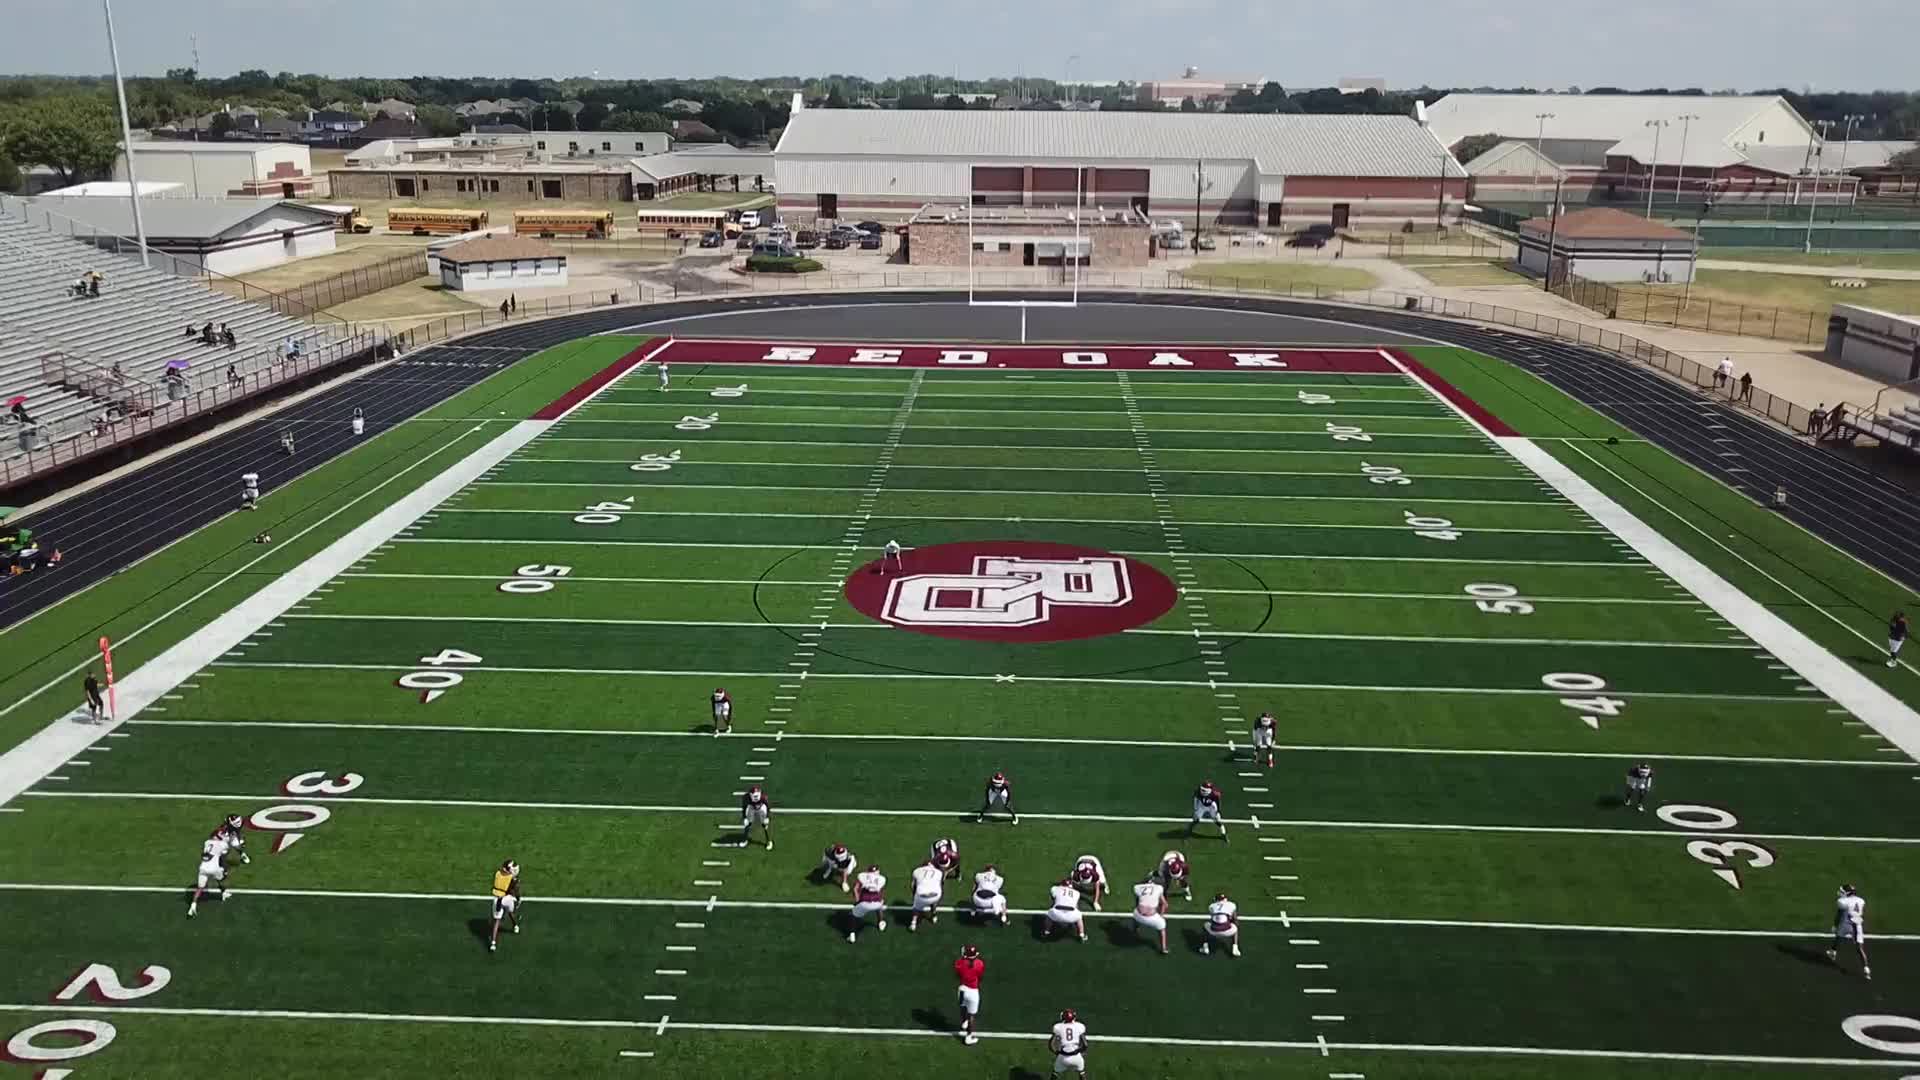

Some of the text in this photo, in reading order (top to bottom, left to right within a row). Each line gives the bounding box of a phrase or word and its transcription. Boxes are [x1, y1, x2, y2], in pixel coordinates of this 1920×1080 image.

[762, 346, 1288, 367] RED OAK
[675, 414, 719, 430] 20
[1327, 426, 1373, 442] 20
[630, 453, 682, 471] 30
[1361, 466, 1412, 485] 30
[573, 501, 632, 524] 40
[1405, 516, 1463, 540] 40
[499, 564, 573, 593] 50
[1464, 583, 1535, 614] 50
[398, 648, 483, 689] 40
[1541, 672, 1627, 716] 40
[250, 771, 364, 830] 30
[1656, 804, 1774, 868] 30
[7, 963, 171, 1060] 20
[1065, 1027, 1073, 1042] 8
